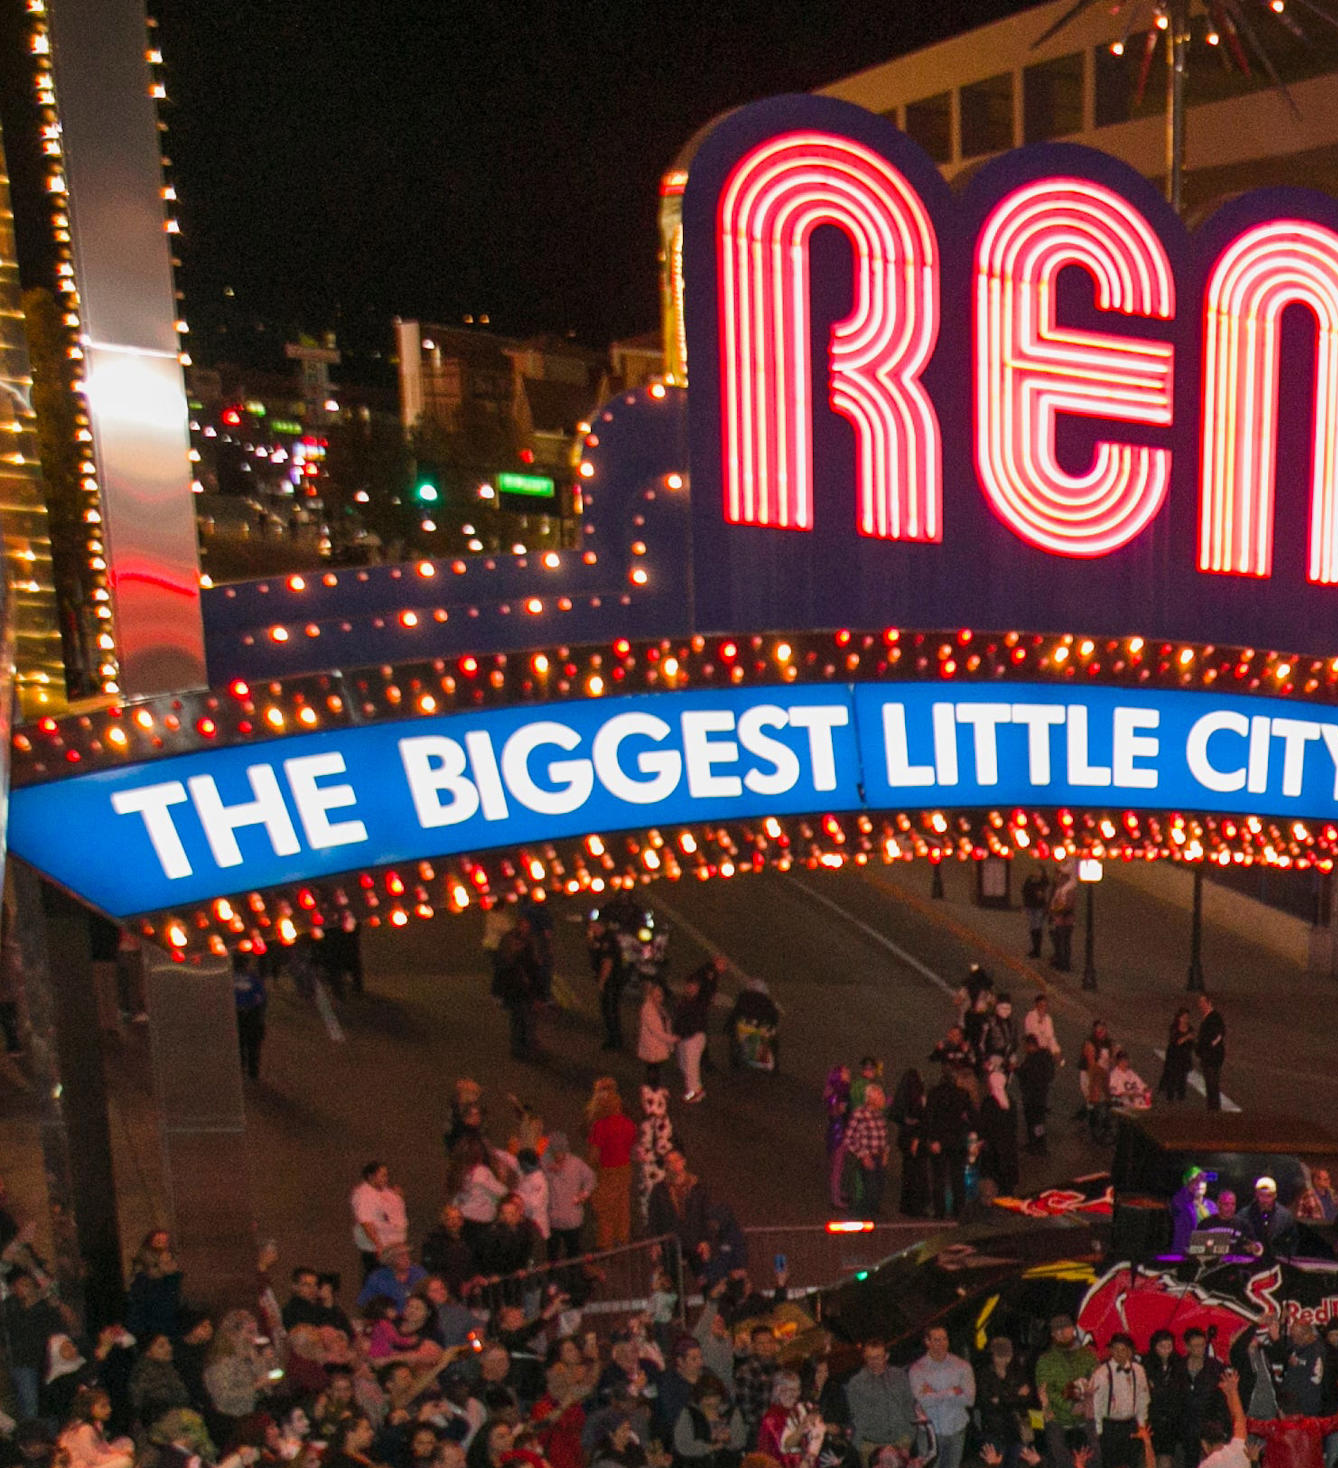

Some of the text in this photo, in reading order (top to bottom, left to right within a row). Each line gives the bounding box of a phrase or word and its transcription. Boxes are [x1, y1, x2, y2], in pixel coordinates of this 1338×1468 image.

[111, 751, 369, 880] THE
[398, 704, 849, 830] BIGGEST
[881, 702, 1161, 790] LITTLE
[1283, 1298, 1330, 1323] Red
